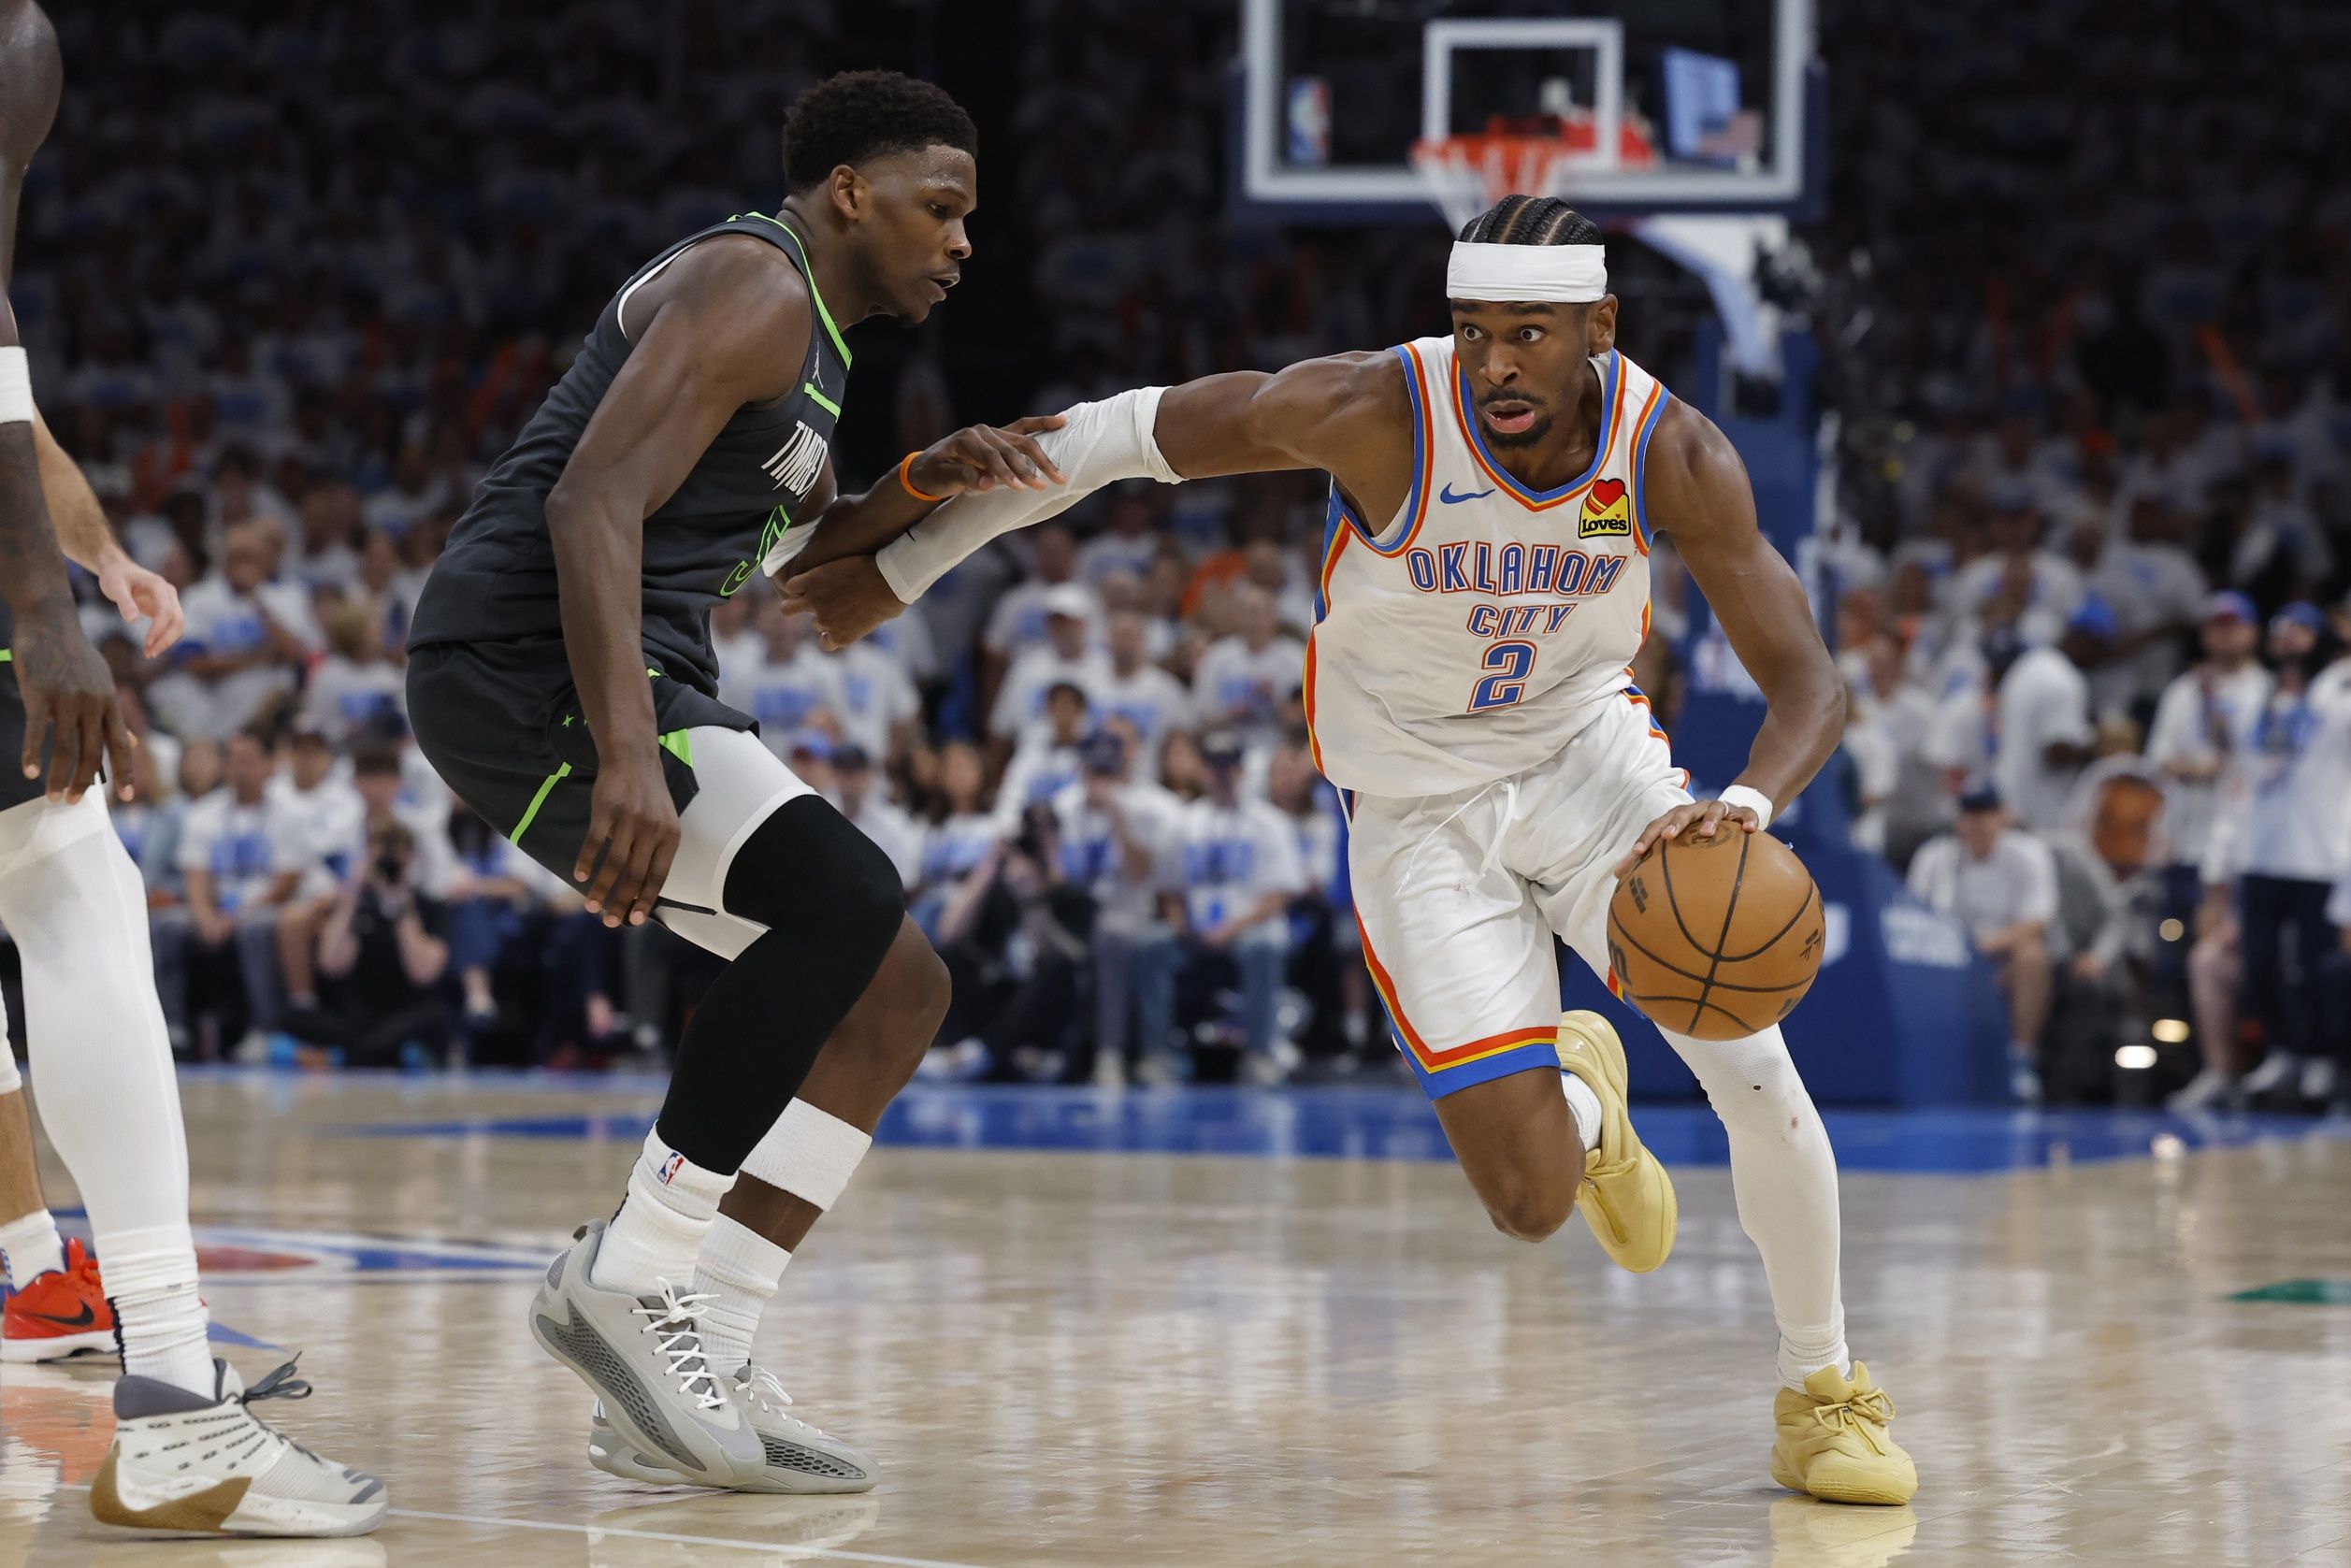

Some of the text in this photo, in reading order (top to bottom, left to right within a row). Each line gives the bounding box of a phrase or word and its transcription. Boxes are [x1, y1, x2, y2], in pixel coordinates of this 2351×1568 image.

[760, 420, 829, 503] TIMBE
[1466, 603, 1578, 640] CITY
[1466, 640, 1537, 712] 2
